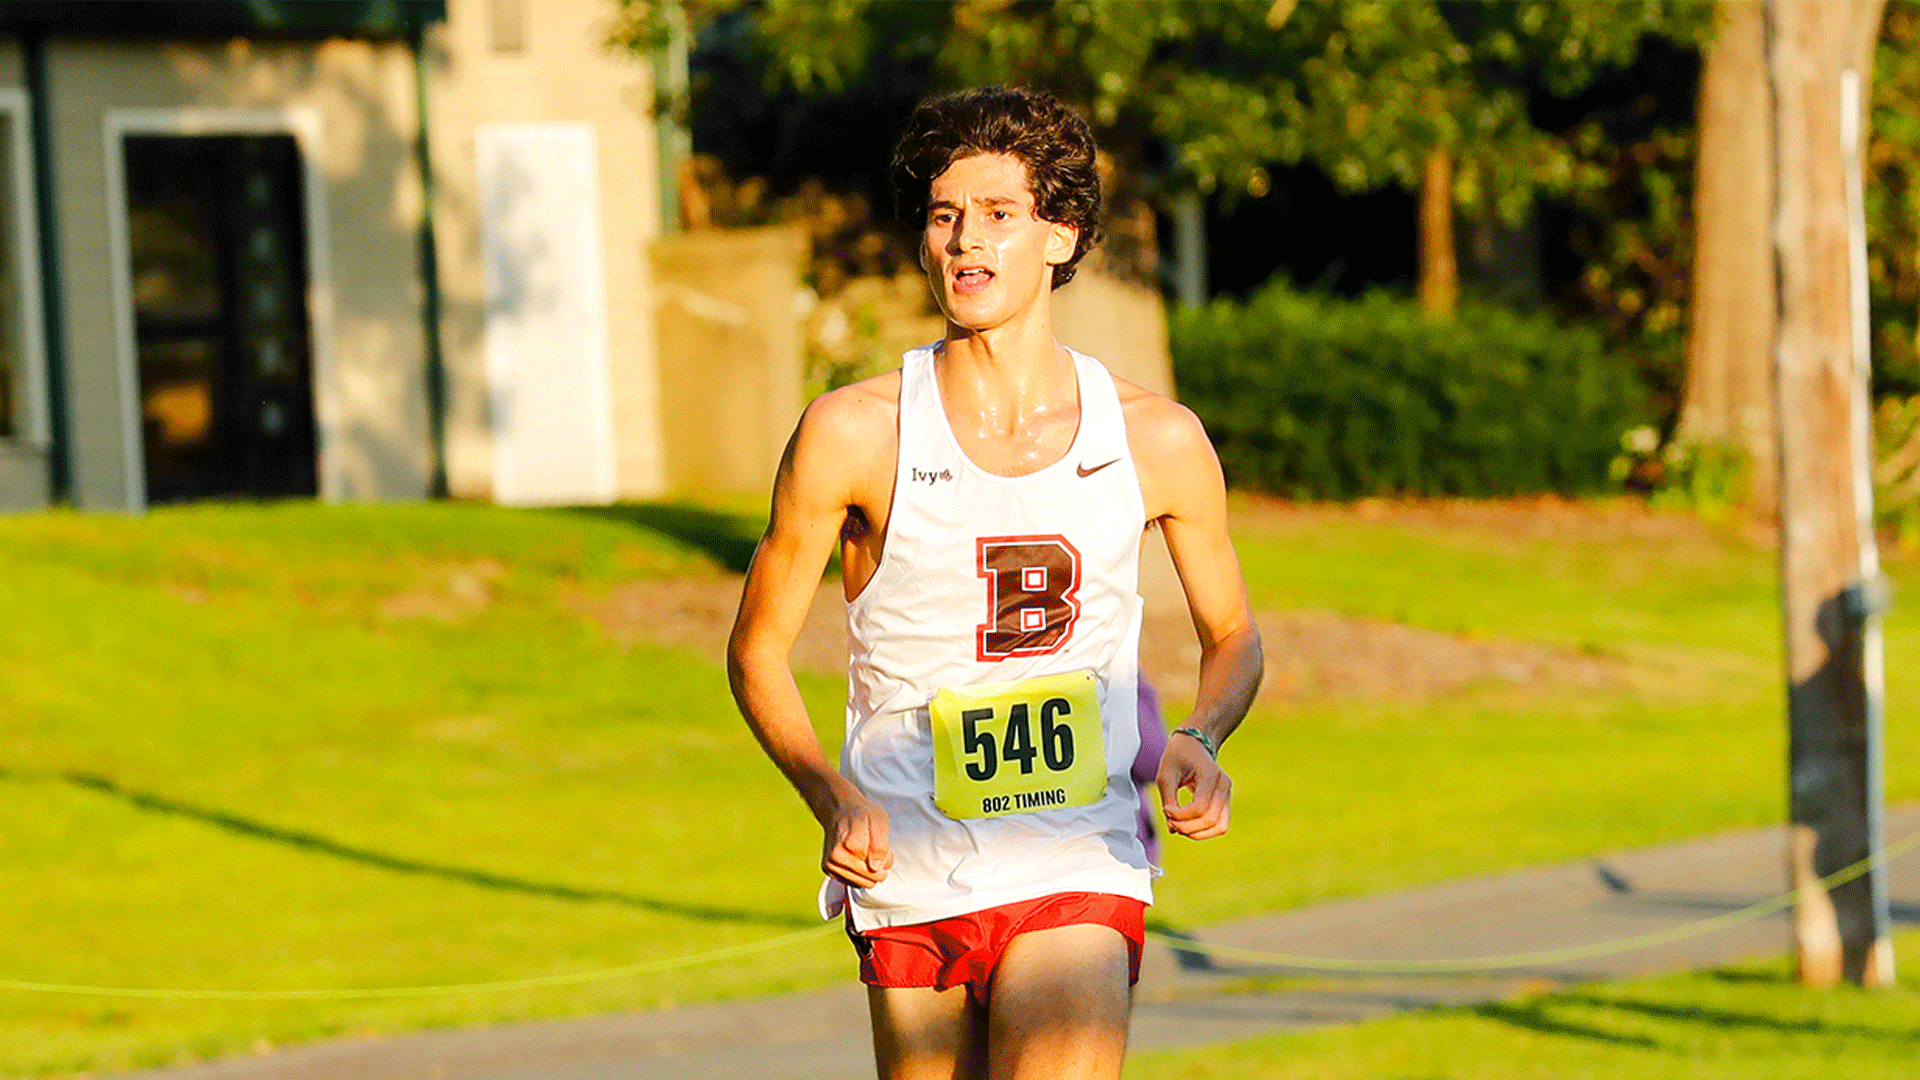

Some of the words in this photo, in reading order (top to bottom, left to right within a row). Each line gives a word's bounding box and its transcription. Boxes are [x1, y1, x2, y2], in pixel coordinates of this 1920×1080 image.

[911, 467, 938, 486] Ivy
[976, 534, 1082, 662] B
[961, 697, 1075, 782] 546
[982, 795, 1011, 813] 802
[1013, 788, 1066, 809] TIMING
